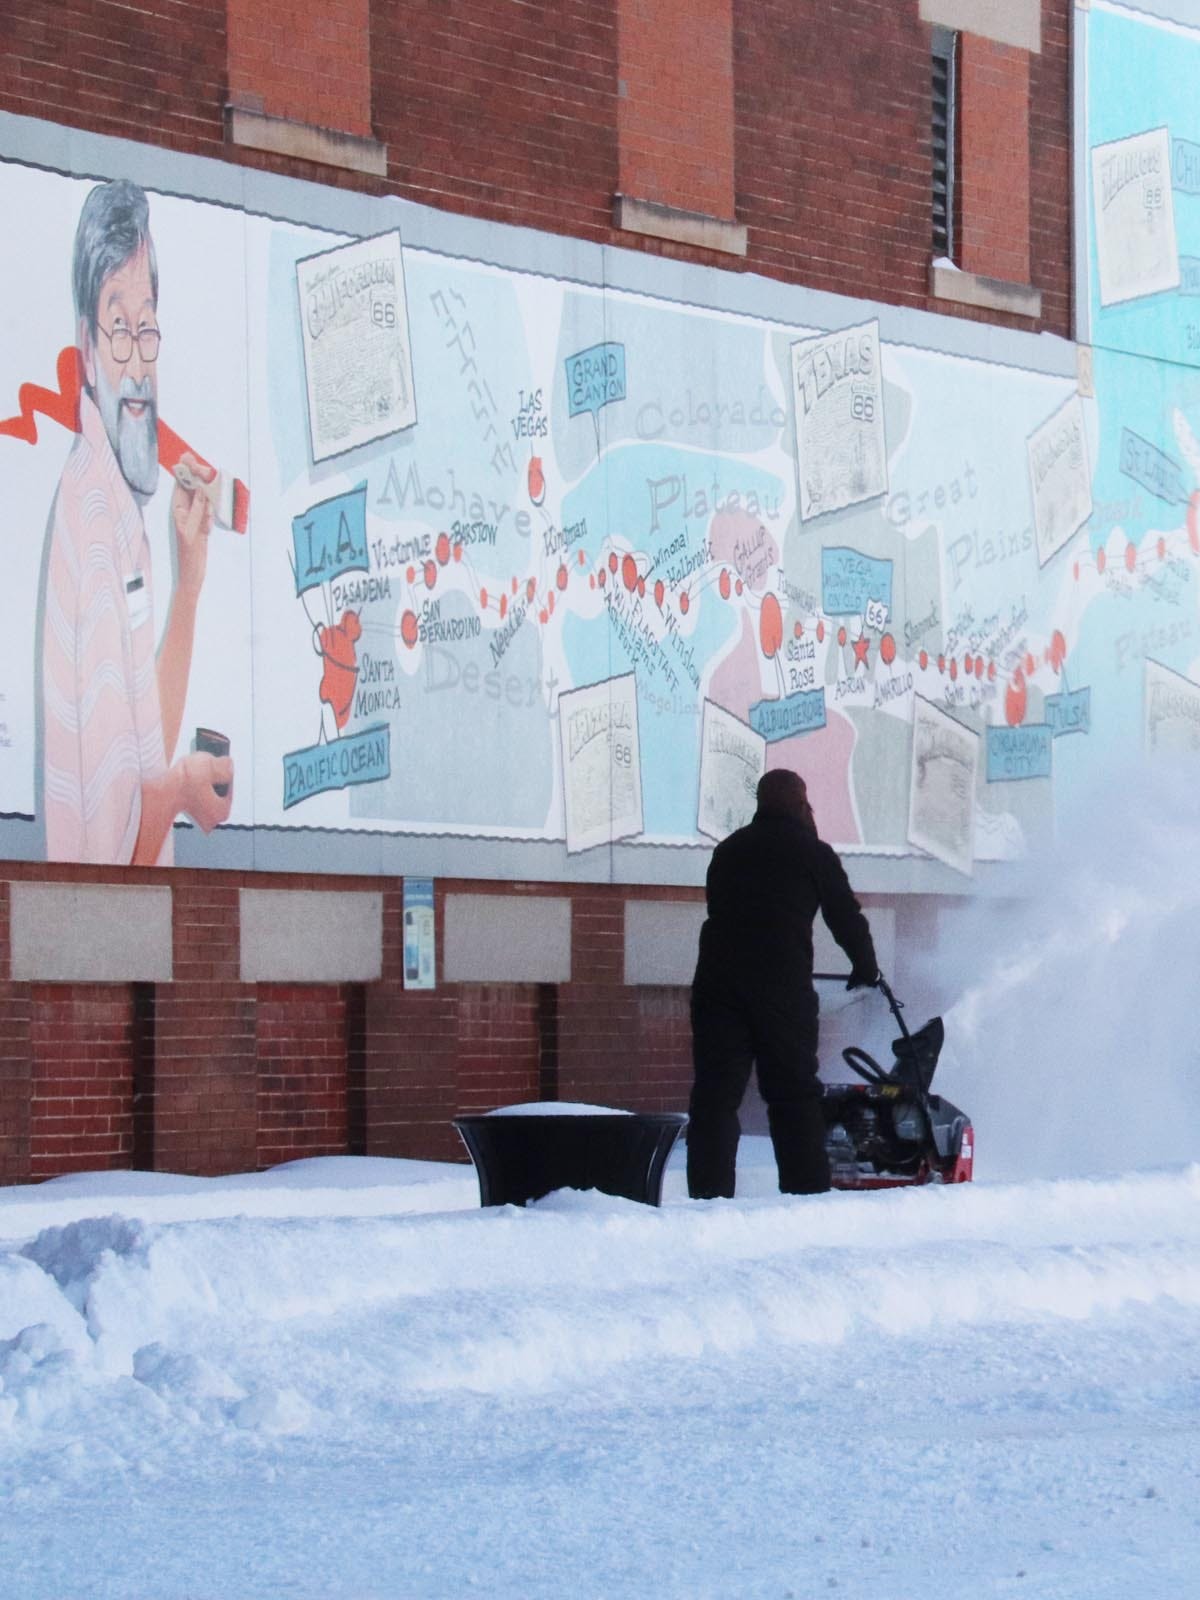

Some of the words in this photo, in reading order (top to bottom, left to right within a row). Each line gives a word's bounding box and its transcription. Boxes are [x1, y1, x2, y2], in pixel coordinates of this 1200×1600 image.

[373, 301, 396, 325] 66
[572, 353, 619, 387] GRAND
[518, 387, 543, 414] LAS
[573, 380, 623, 407] CANYON
[853, 394, 875, 418] 66
[510, 416, 548, 441] VEGAS
[636, 385, 786, 441] Colorado
[376, 455, 532, 538] Mohave
[646, 472, 780, 537] Plateau
[887, 458, 978, 527] Great
[304, 510, 364, 578] L.A.
[543, 518, 588, 557] Kingman
[947, 524, 1033, 592] Plains
[333, 576, 392, 612] PASADENA
[422, 597, 442, 621] SAN
[419, 616, 482, 645] BERNARDINO
[868, 605, 884, 625] 66
[787, 639, 816, 662] Santa
[359, 653, 395, 686] SANTA
[789, 666, 815, 690] Rosa
[354, 688, 402, 718] MONICA
[287, 755, 337, 799] PACIFIC
[341, 742, 386, 777] OCEAN
